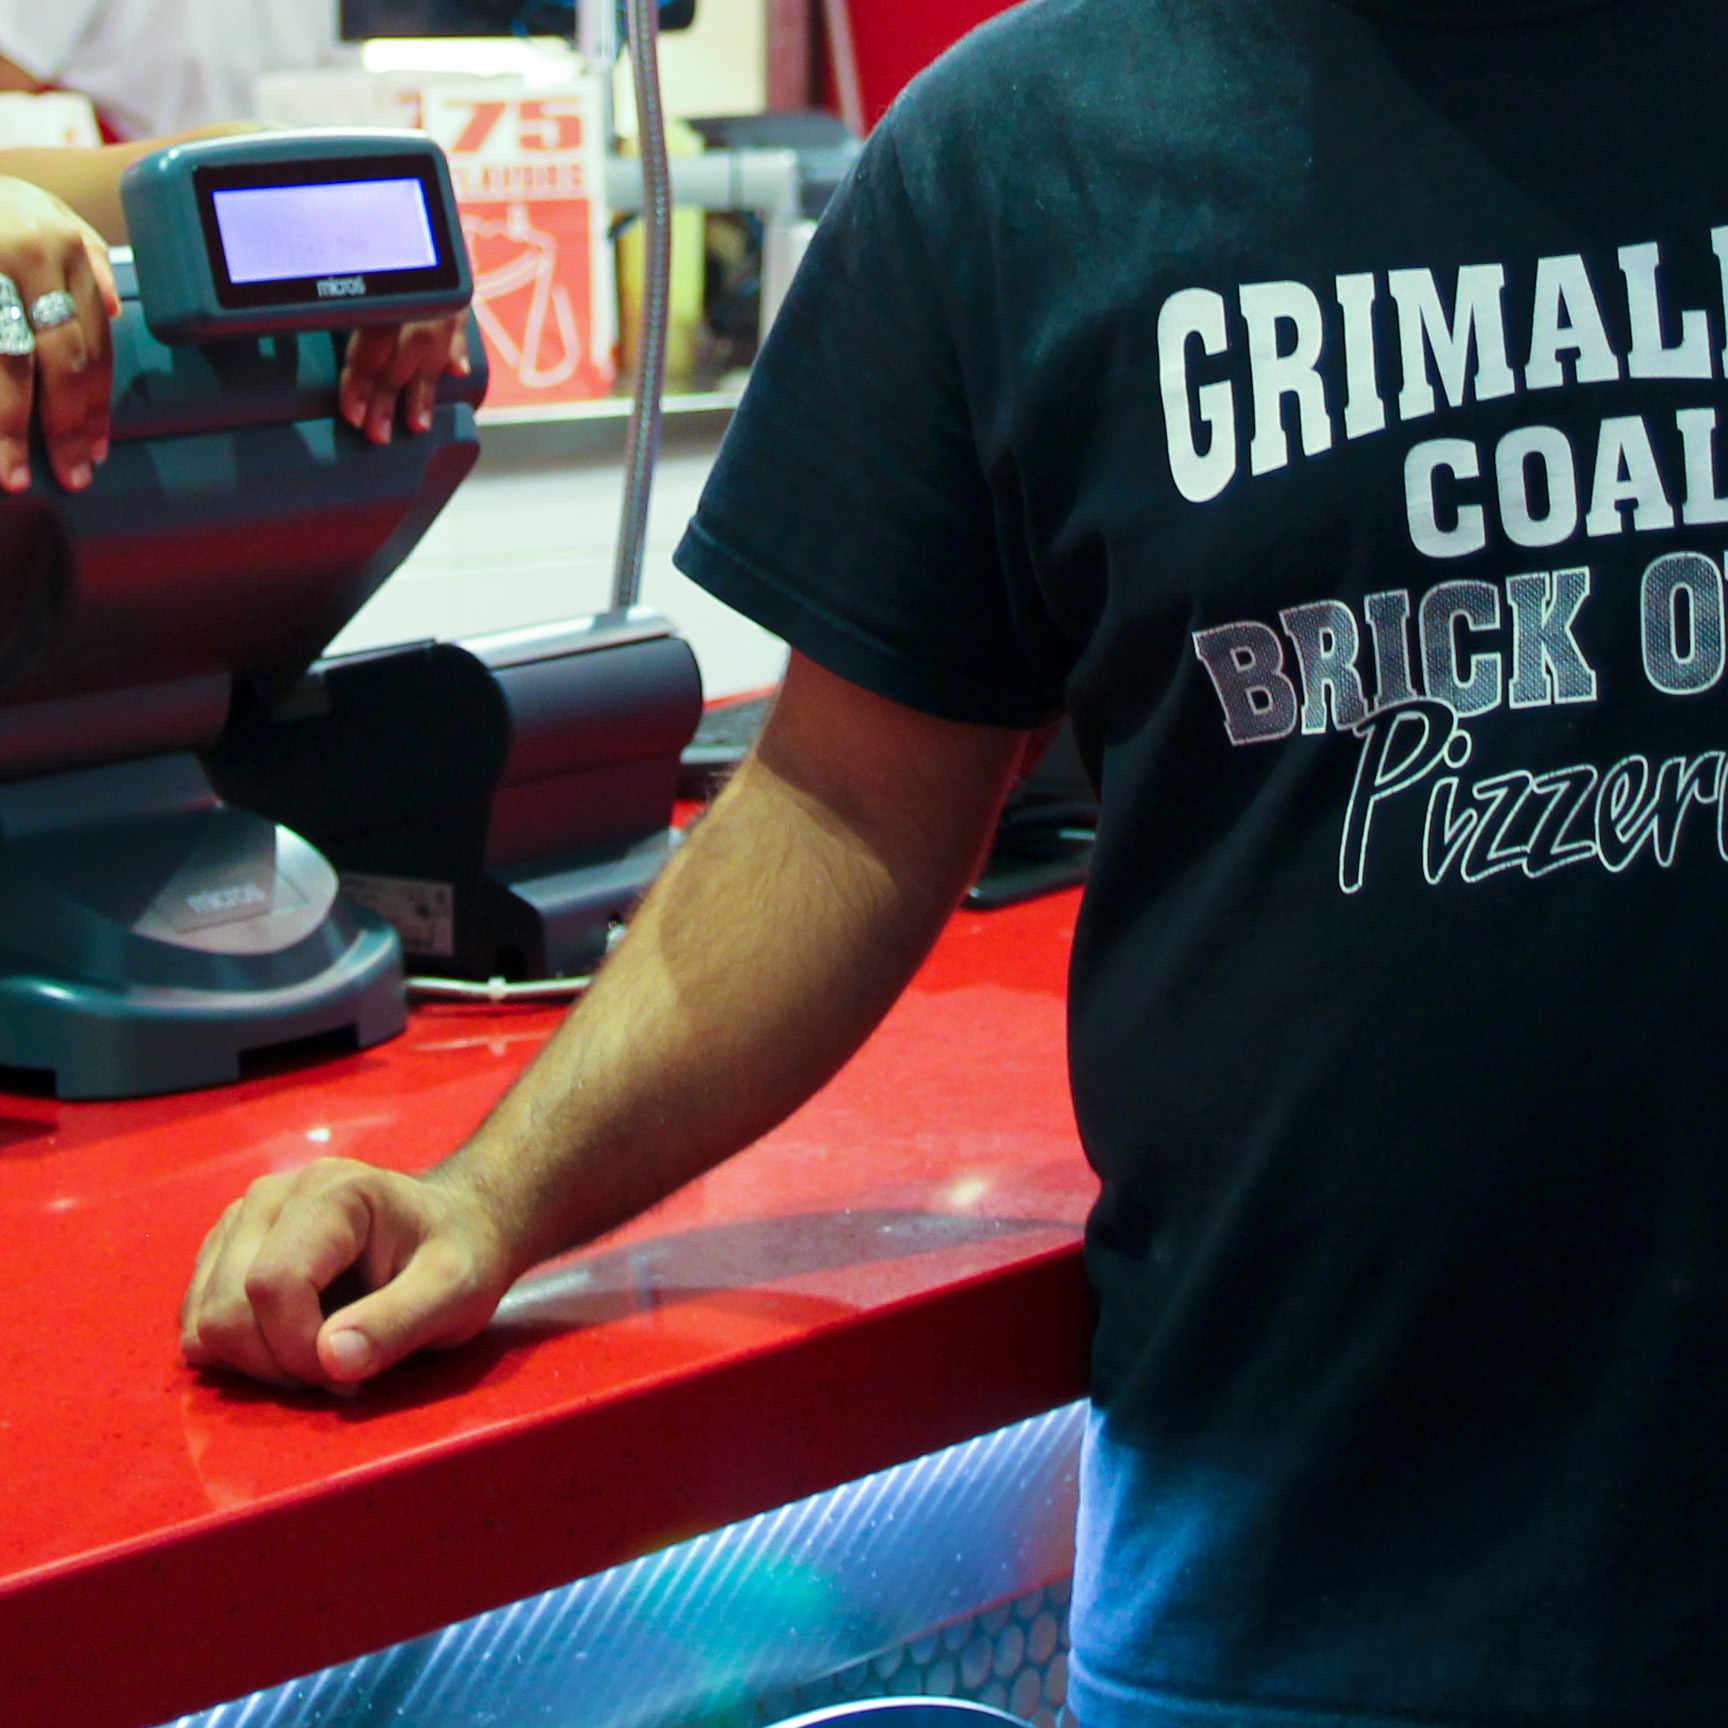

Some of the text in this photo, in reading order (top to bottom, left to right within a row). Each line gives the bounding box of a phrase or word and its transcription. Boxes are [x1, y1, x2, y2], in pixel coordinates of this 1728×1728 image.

[444, 95, 584, 154] 75
[452, 163, 584, 193] LAVORS
[1192, 567, 1598, 746] BRICK
